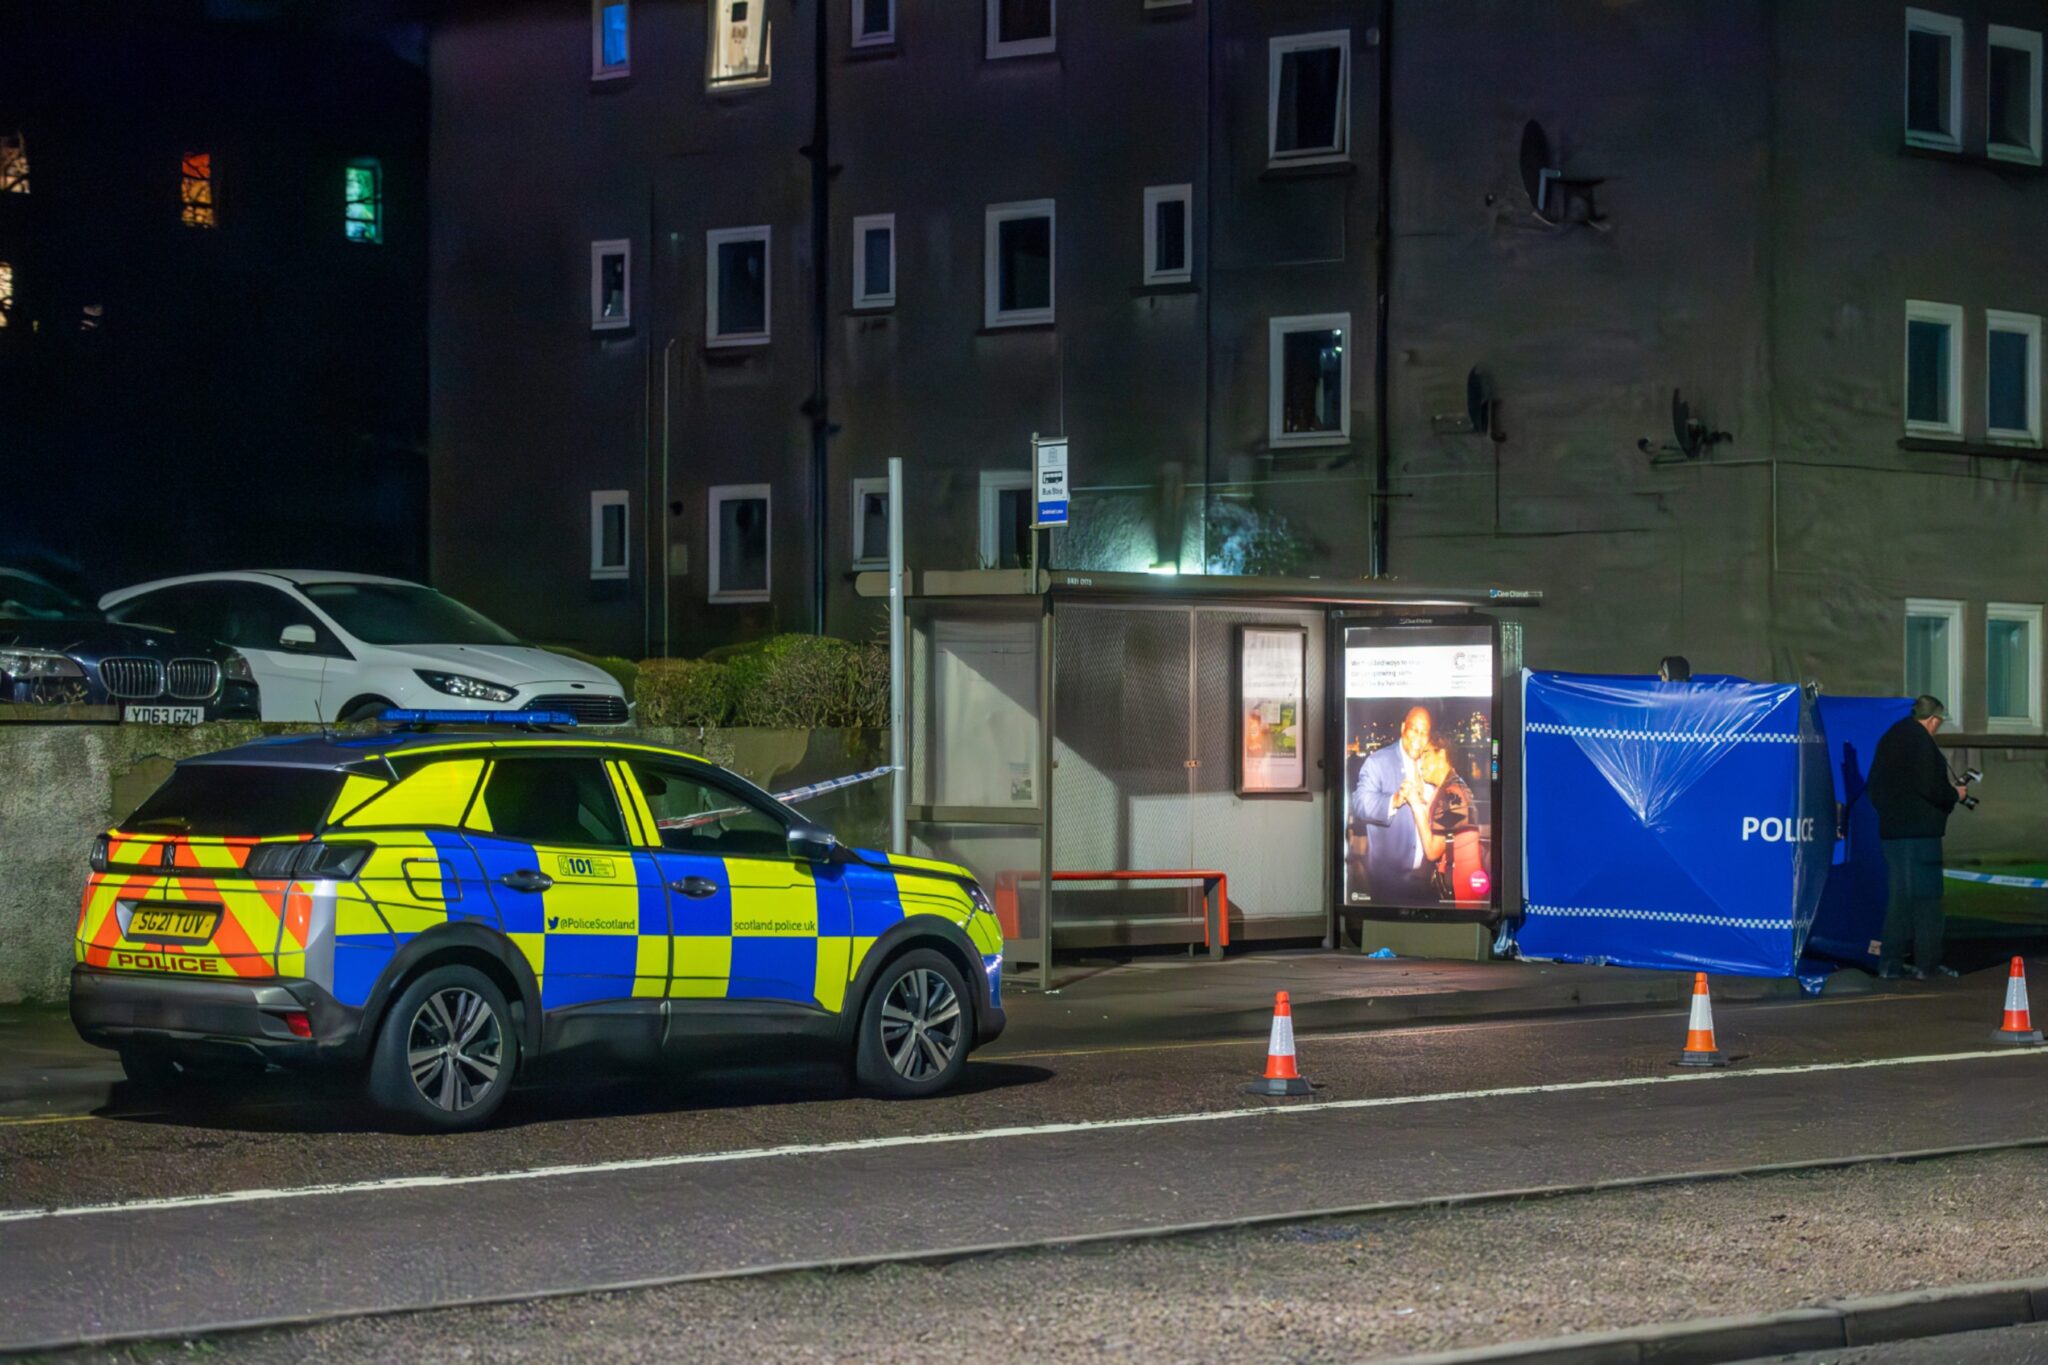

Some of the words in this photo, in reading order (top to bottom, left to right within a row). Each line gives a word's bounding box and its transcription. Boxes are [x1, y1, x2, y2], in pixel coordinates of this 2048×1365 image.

[173, 708, 199, 725] GZH
[1742, 816, 1815, 842] POLICE
[568, 857, 594, 875] 101
[137, 911, 172, 932] SG21
[176, 913, 207, 934] TUV
[560, 918, 636, 930] @PoliceScotland
[734, 919, 816, 932] scotland.police.uk
[117, 953, 220, 973] POLICE
